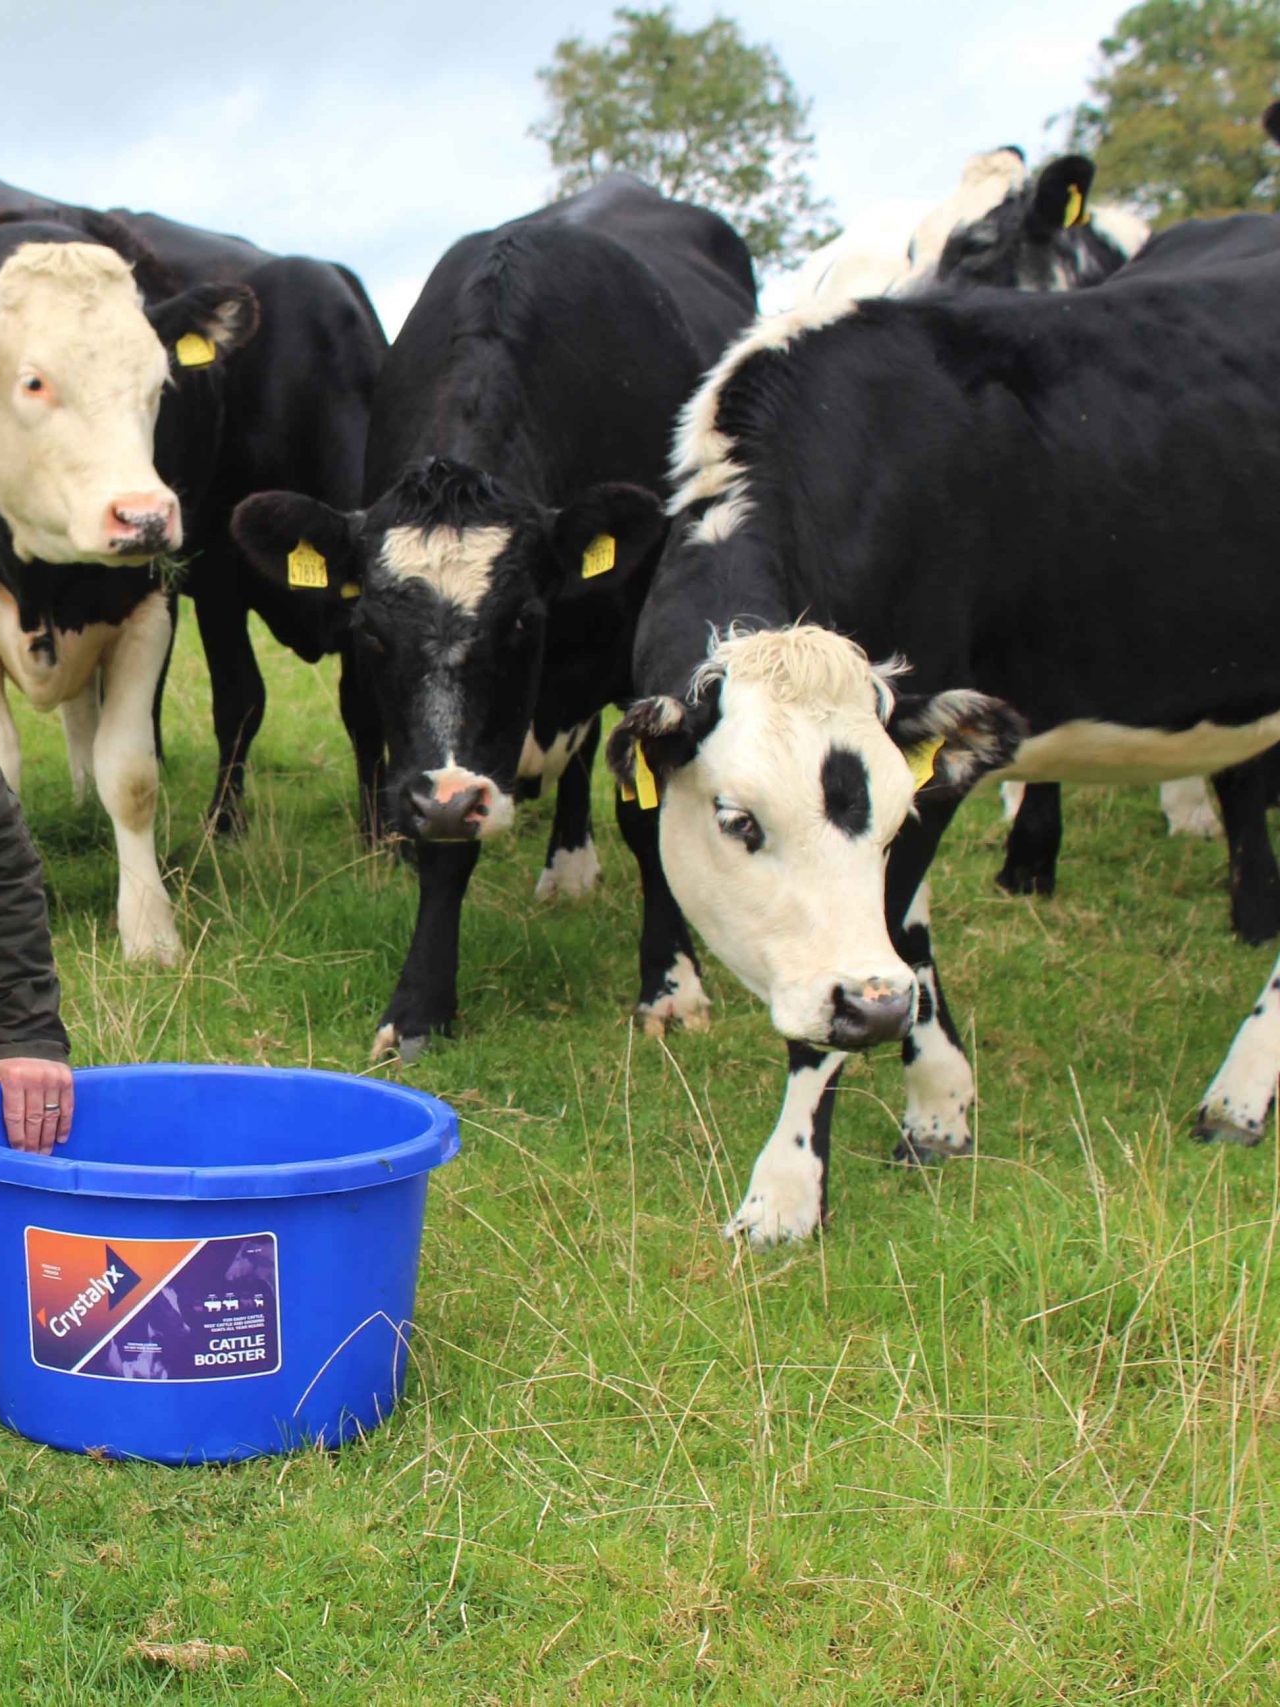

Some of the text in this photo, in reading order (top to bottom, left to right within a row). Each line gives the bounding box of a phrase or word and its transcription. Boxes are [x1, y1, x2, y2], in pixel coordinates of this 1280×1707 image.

[49, 1264, 125, 1338] Crystalyx
[209, 1334, 266, 1351] CATTLE
[194, 1348, 266, 1366] BOOSTER
